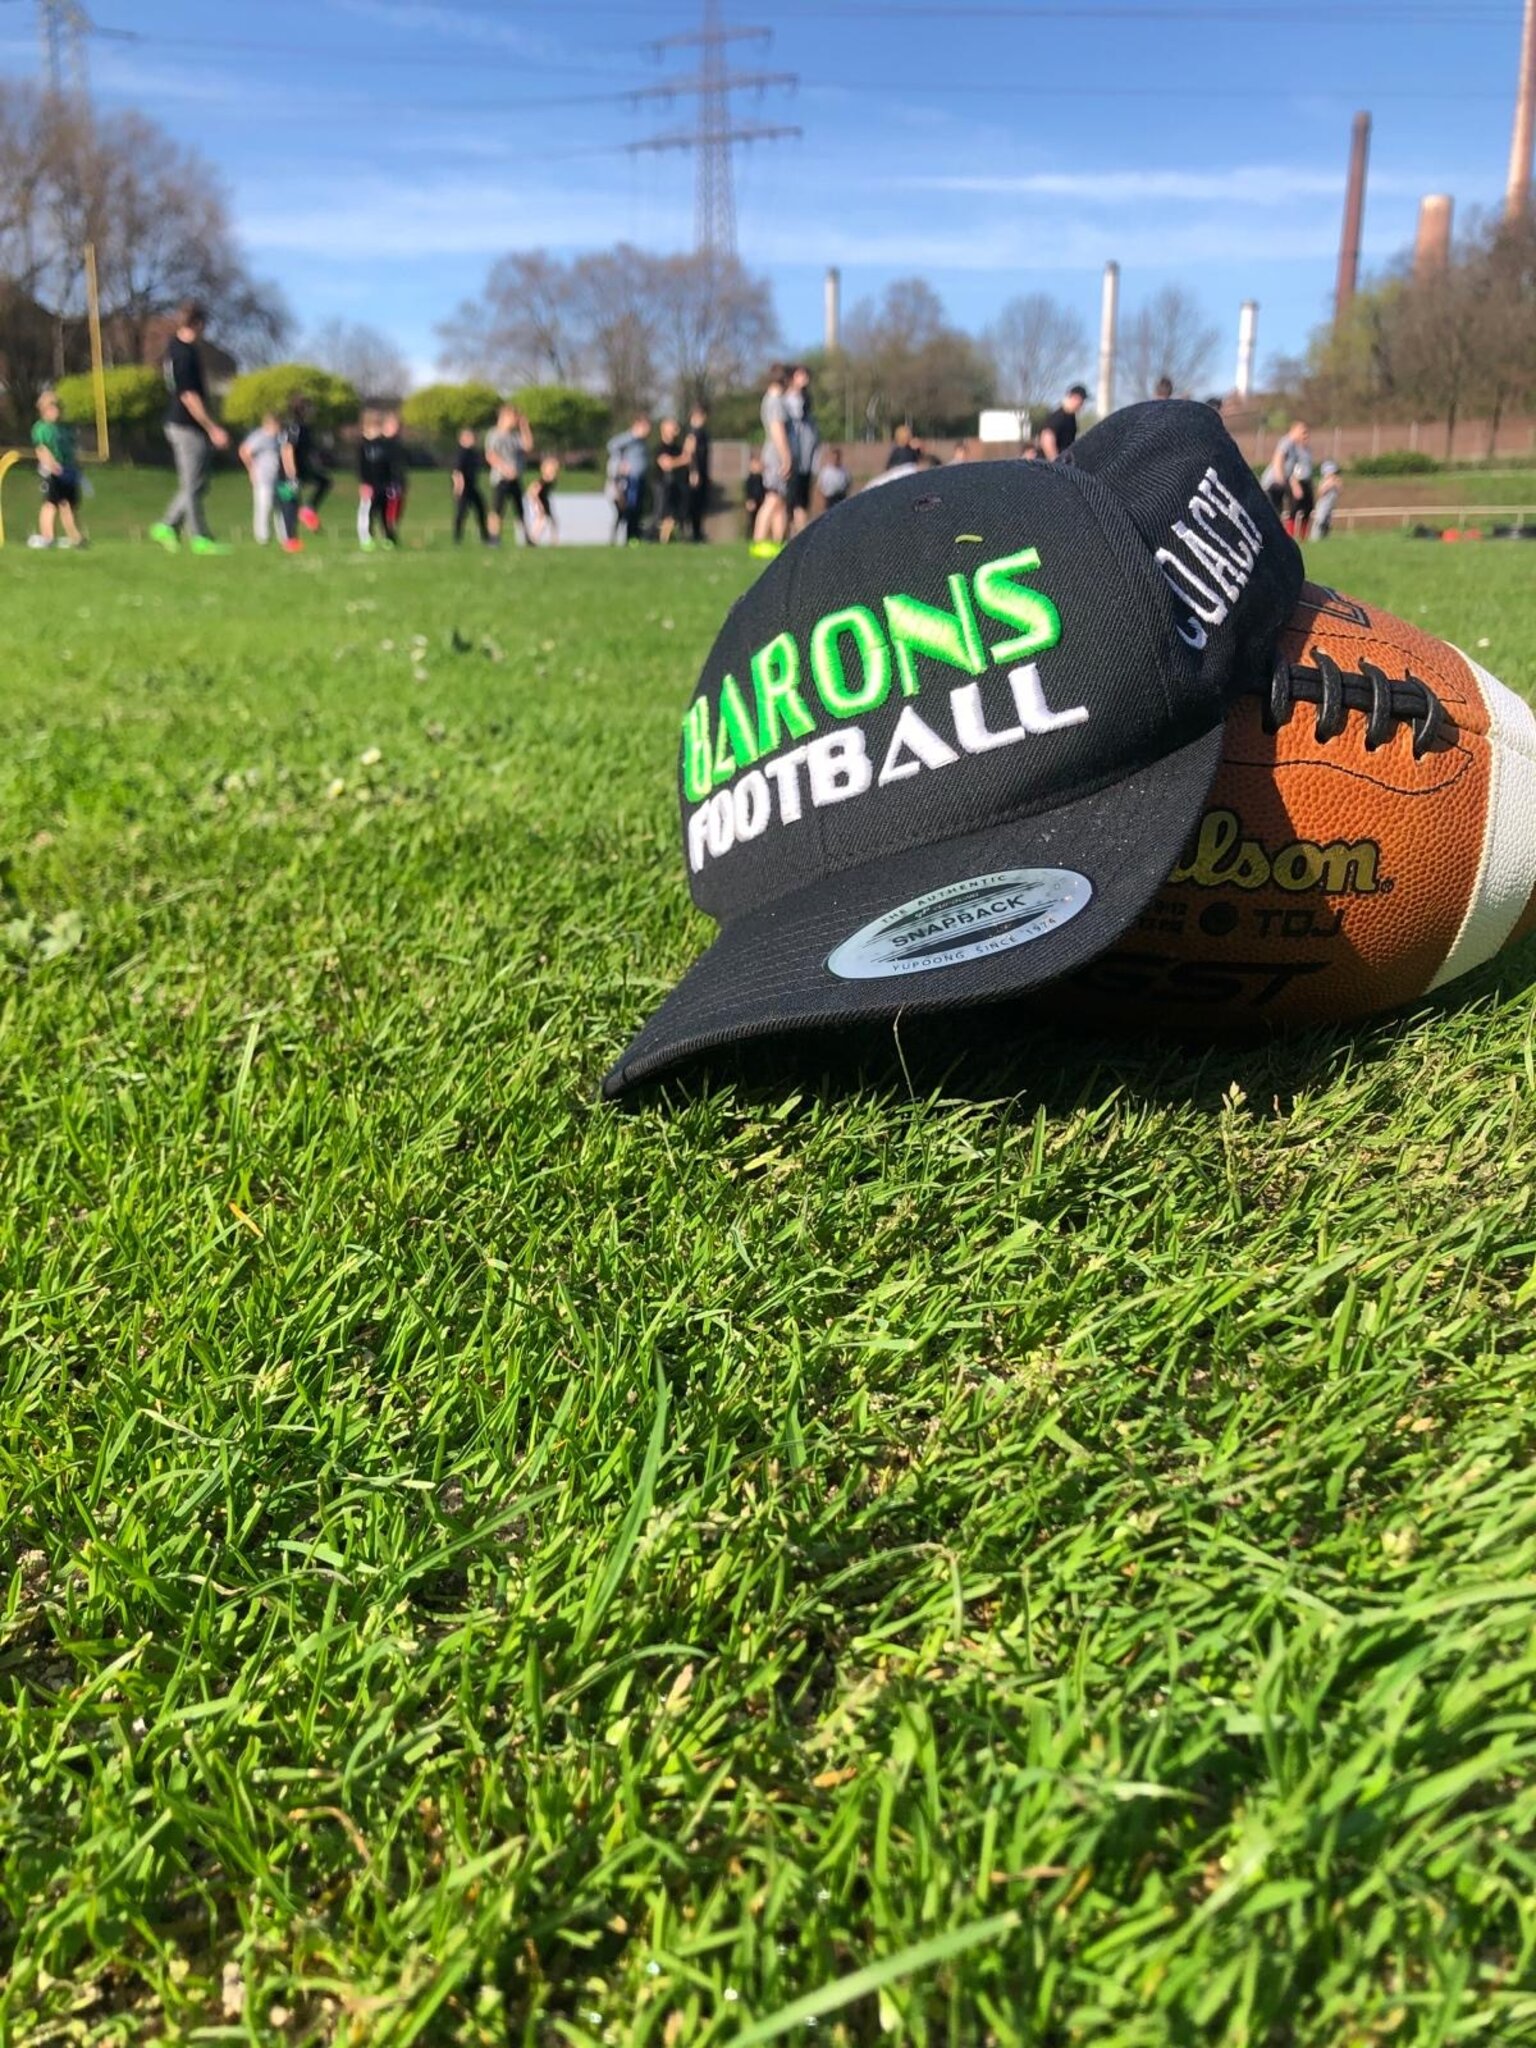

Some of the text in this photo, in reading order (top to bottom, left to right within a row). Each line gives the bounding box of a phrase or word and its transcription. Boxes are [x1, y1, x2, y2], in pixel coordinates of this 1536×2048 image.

[682, 546, 1061, 803] BARONS
[688, 662, 1090, 874] FOOTBALL
[881, 908, 908, 924] THE
[917, 874, 1006, 906] AUTHENTIC
[891, 894, 1027, 947] SNAPBACK
[892, 917, 1057, 972] YUPOONG SINCE 1974
